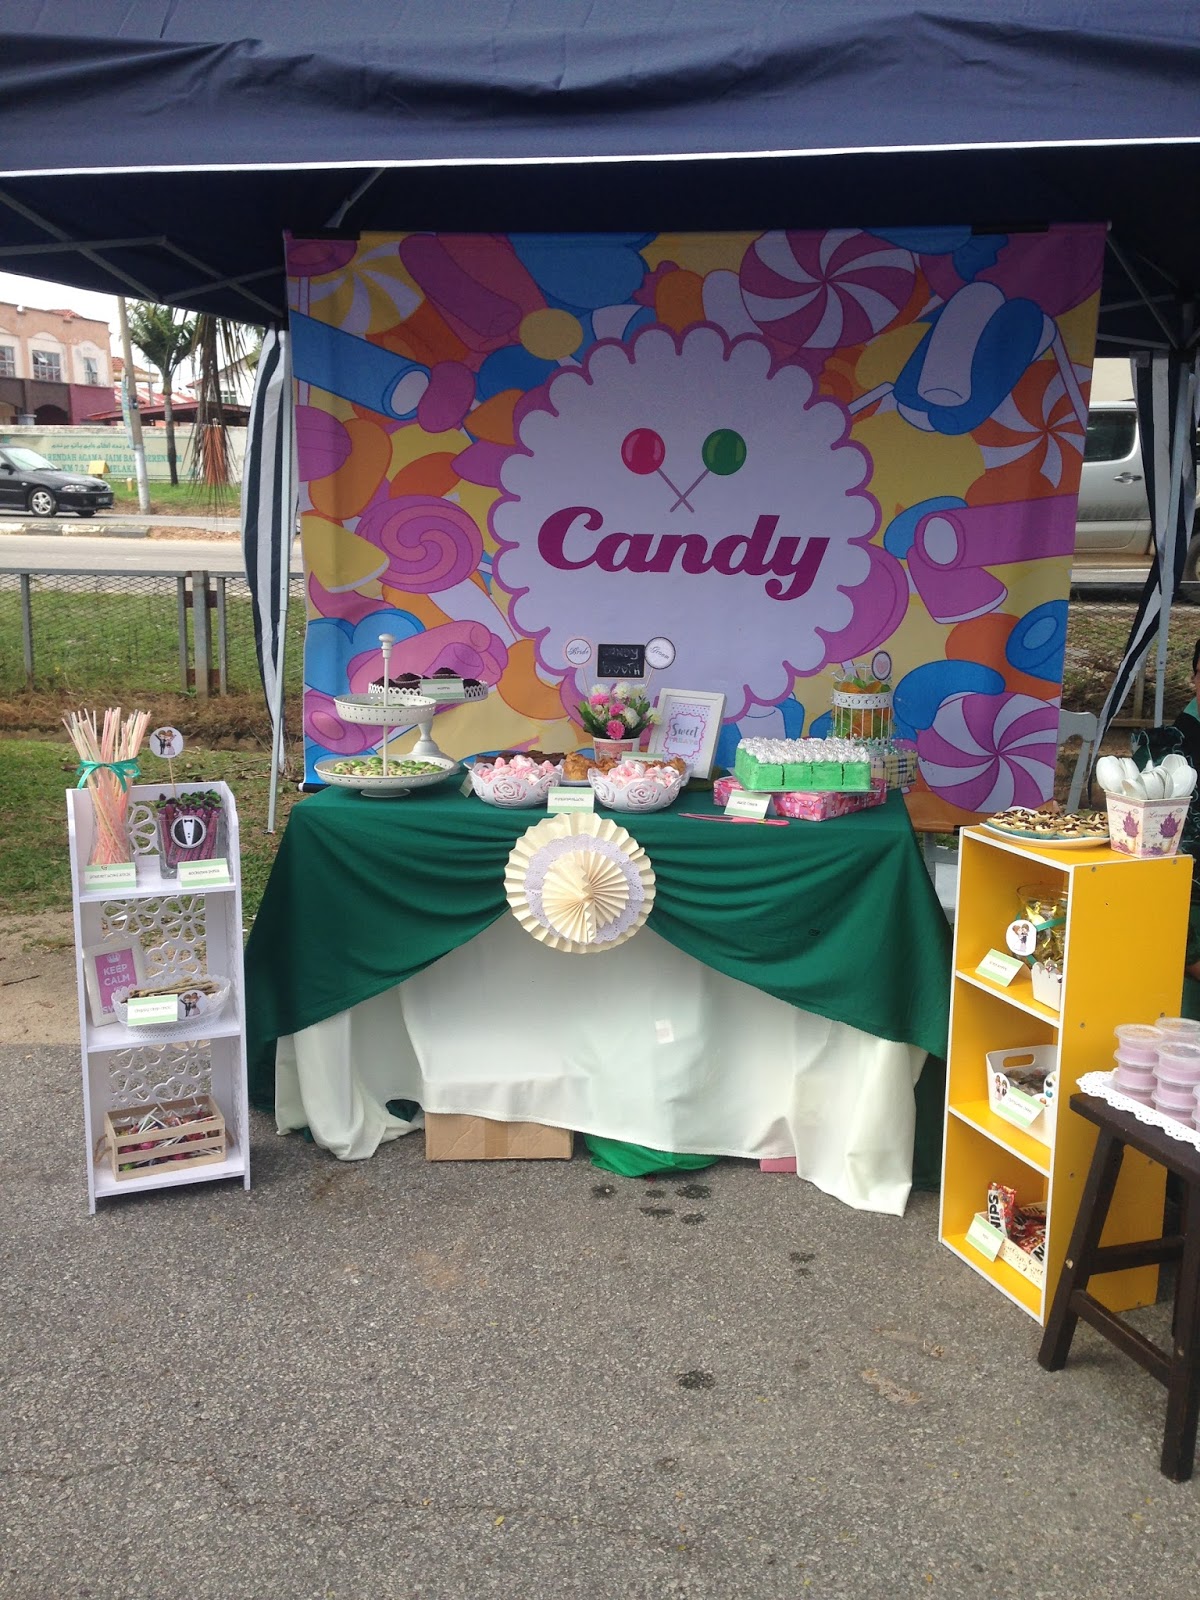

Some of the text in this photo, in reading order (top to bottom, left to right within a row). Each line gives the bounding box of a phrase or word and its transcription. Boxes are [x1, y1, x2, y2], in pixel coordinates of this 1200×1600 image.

[537, 506, 830, 601] Candy
[568, 646, 589, 656] Bride
[671, 722, 699, 738] Sweet
[103, 963, 128, 976] KEEP
[104, 974, 130, 986] CALM
